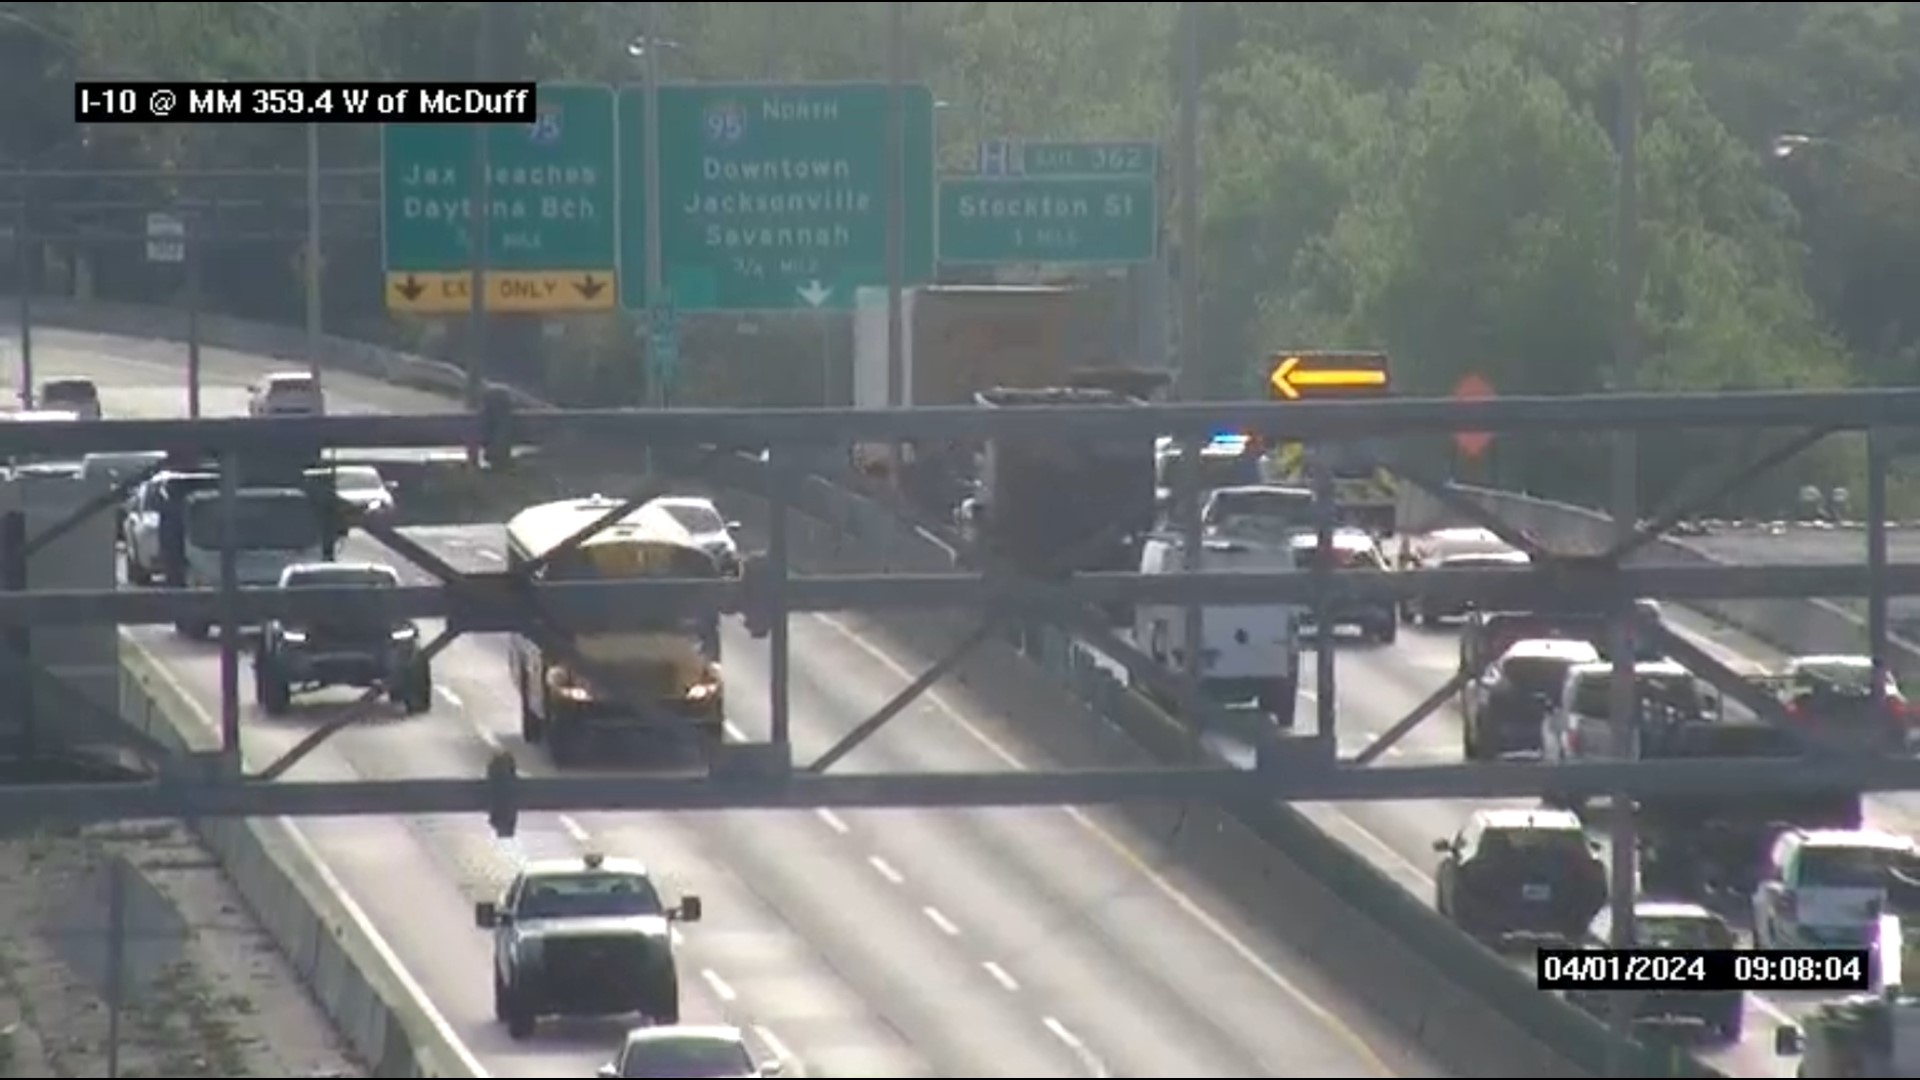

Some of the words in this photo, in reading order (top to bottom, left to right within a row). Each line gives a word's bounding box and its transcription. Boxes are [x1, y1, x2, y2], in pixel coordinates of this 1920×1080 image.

[707, 113, 743, 140] 95
[703, 156, 850, 181] Downtown
[1090, 147, 1144, 169] 362
[402, 162, 457, 186] Jax
[485, 162, 597, 186] eaches
[403, 195, 526, 226] Daytna
[541, 195, 595, 219] Bch
[684, 189, 870, 214] Jacksonville
[957, 193, 1088, 218] Stockton
[1103, 191, 1134, 218] St
[705, 222, 850, 248] Savannah
[500, 278, 557, 298] ONLY
